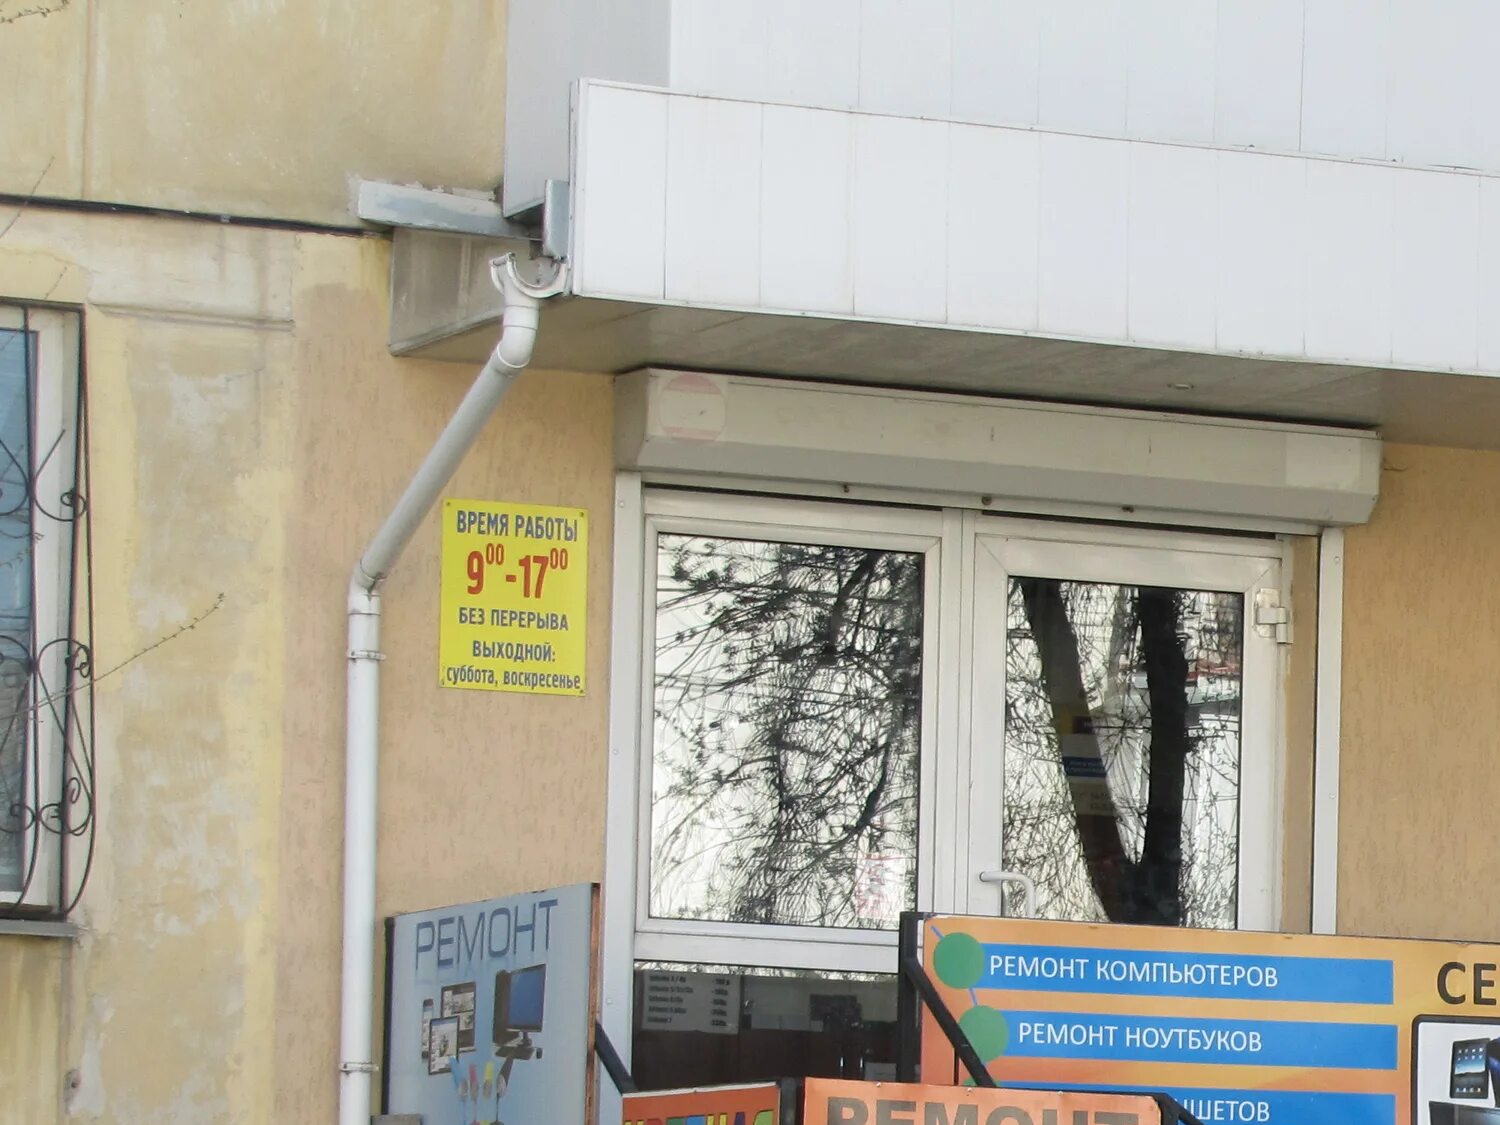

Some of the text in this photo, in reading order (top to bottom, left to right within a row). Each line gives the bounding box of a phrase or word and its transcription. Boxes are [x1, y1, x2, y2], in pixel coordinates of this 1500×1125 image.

[457, 510, 578, 542] ВРЕМЯ РАБОТЫ
[459, 607, 568, 631] БЕЗ ПЕРЕРЫВА
[472, 640, 556, 662] ВЫХОДНОЙ:
[446, 665, 581, 690] суббота, воскресенье
[415, 898, 559, 970] РЕМОНТ
[989, 955, 1278, 988] РЕМОНТ КОМПЬЮТЕРОВ
[1018, 1022, 1263, 1053] РЕМОНТ НОУТБУКОВ
[1183, 1099, 1270, 1122] ШЕТОВ
